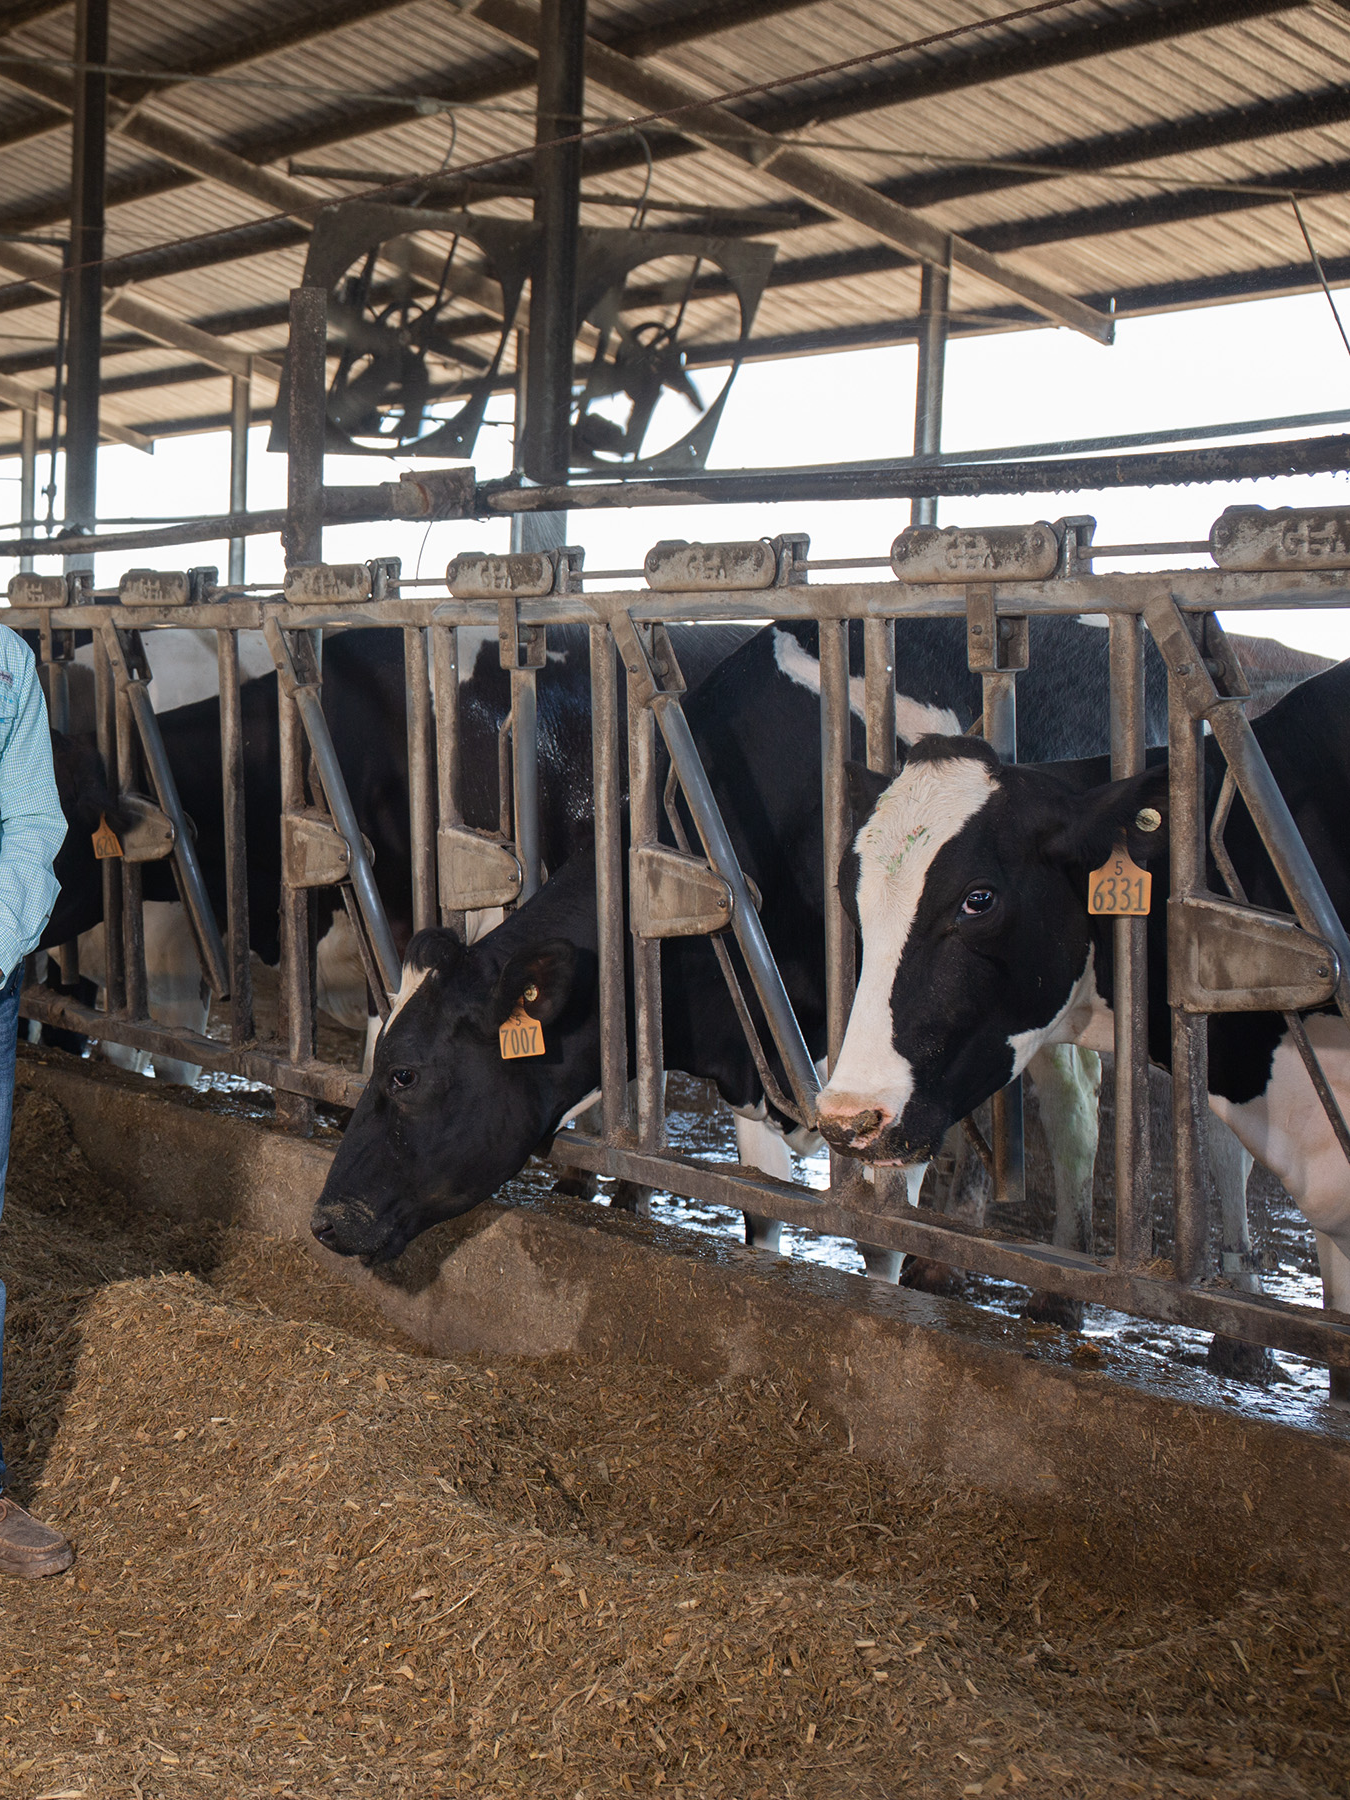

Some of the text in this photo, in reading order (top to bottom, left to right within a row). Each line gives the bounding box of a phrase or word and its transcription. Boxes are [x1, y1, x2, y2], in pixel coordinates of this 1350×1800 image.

[1114, 860, 1123, 876] 5
[1092, 877, 1147, 913] 6331
[515, 1014, 522, 1027] 5
[501, 1026, 538, 1057] 7007
